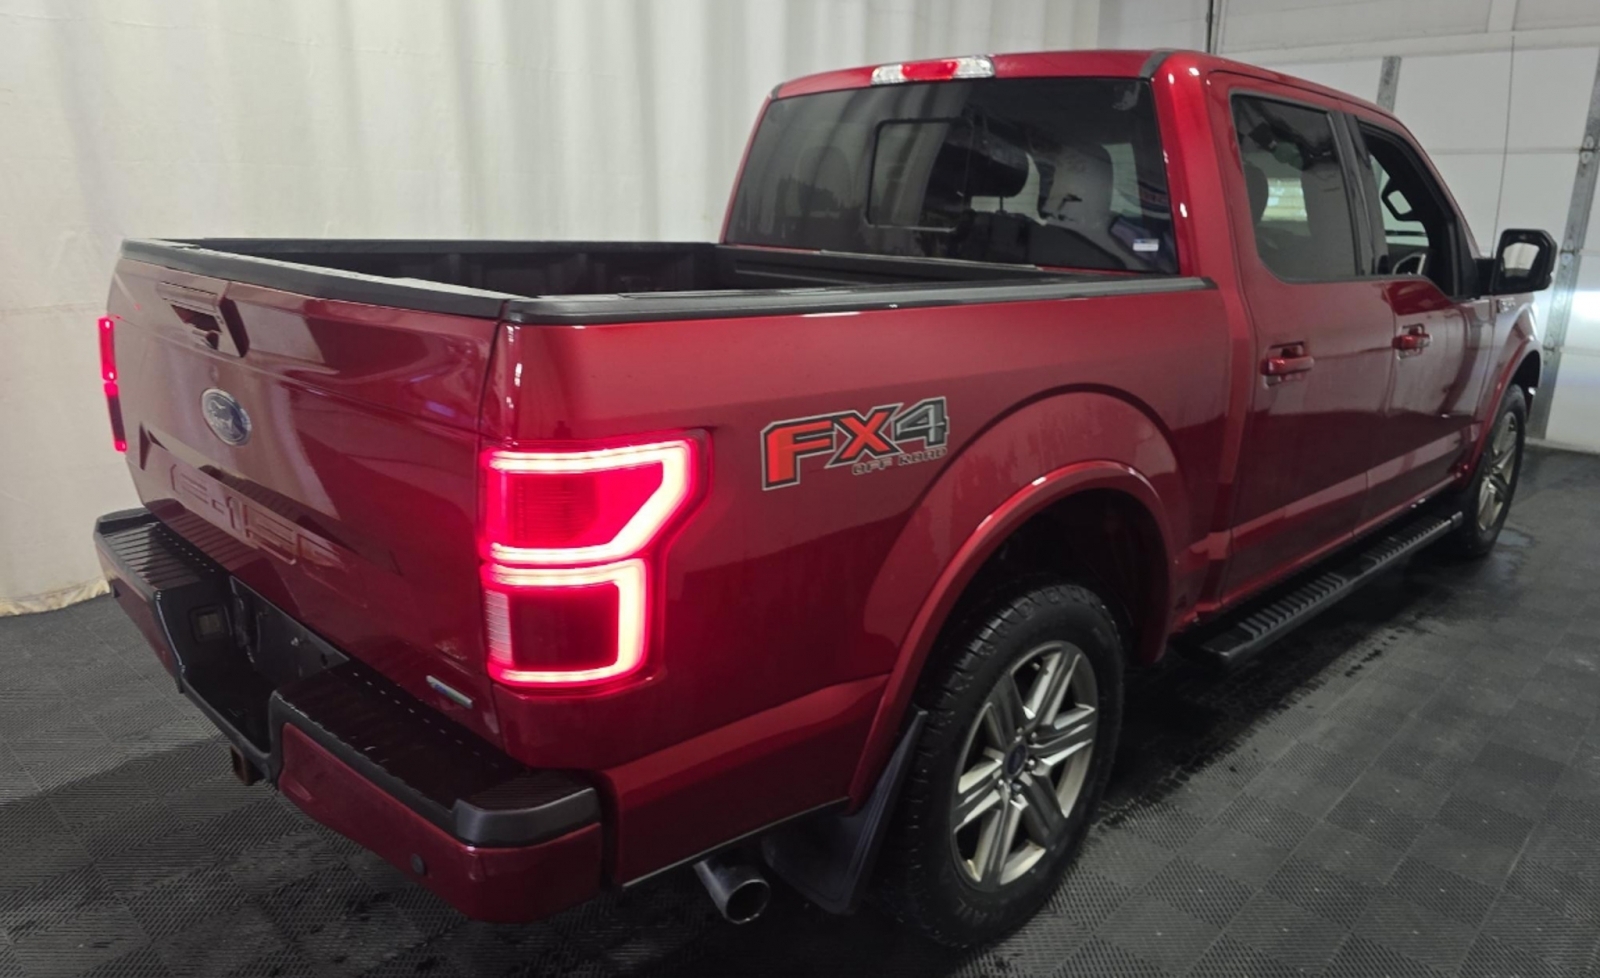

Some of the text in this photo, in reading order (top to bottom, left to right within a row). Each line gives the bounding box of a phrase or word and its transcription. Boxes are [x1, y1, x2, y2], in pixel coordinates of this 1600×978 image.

[761, 396, 949, 490] FX4
[852, 447, 948, 475] OFF ROAD
